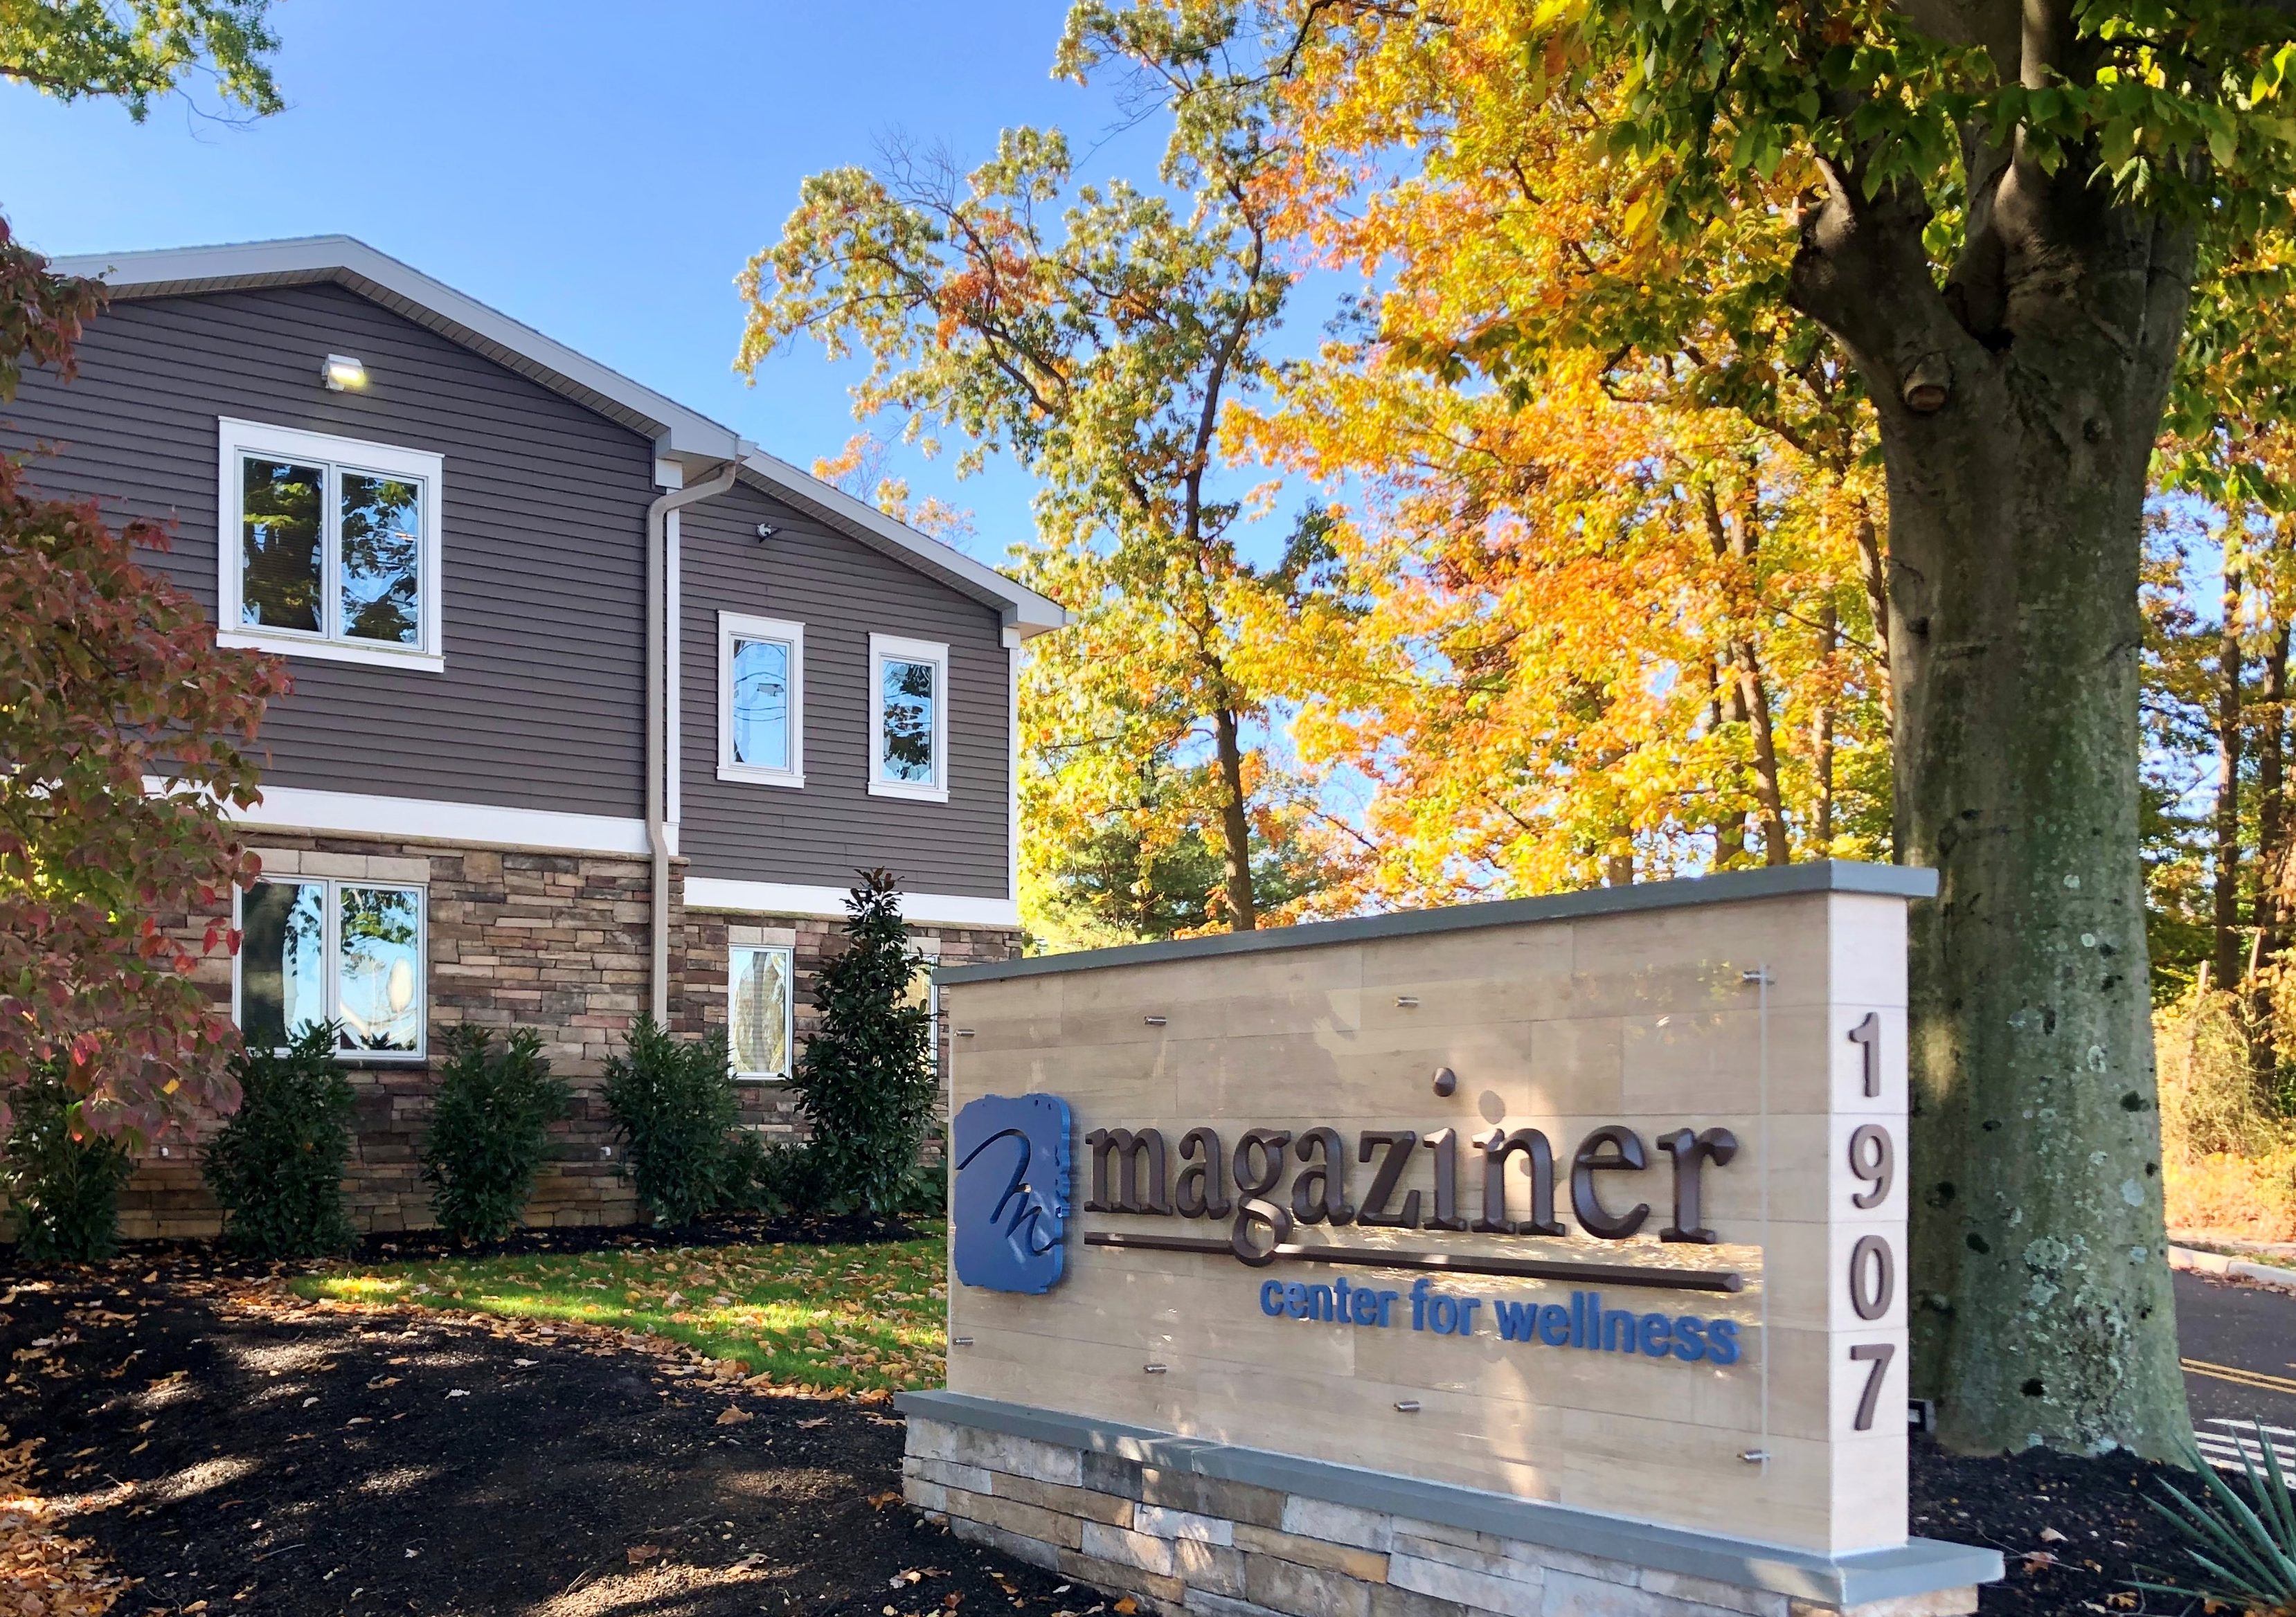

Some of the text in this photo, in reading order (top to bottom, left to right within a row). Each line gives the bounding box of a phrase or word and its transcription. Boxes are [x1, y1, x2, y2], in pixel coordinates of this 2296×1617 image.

[1084, 1067, 1738, 1267] magaziner
[1847, 1011, 1896, 1431] 1907
[1259, 1276, 1742, 1366] center for wellness
